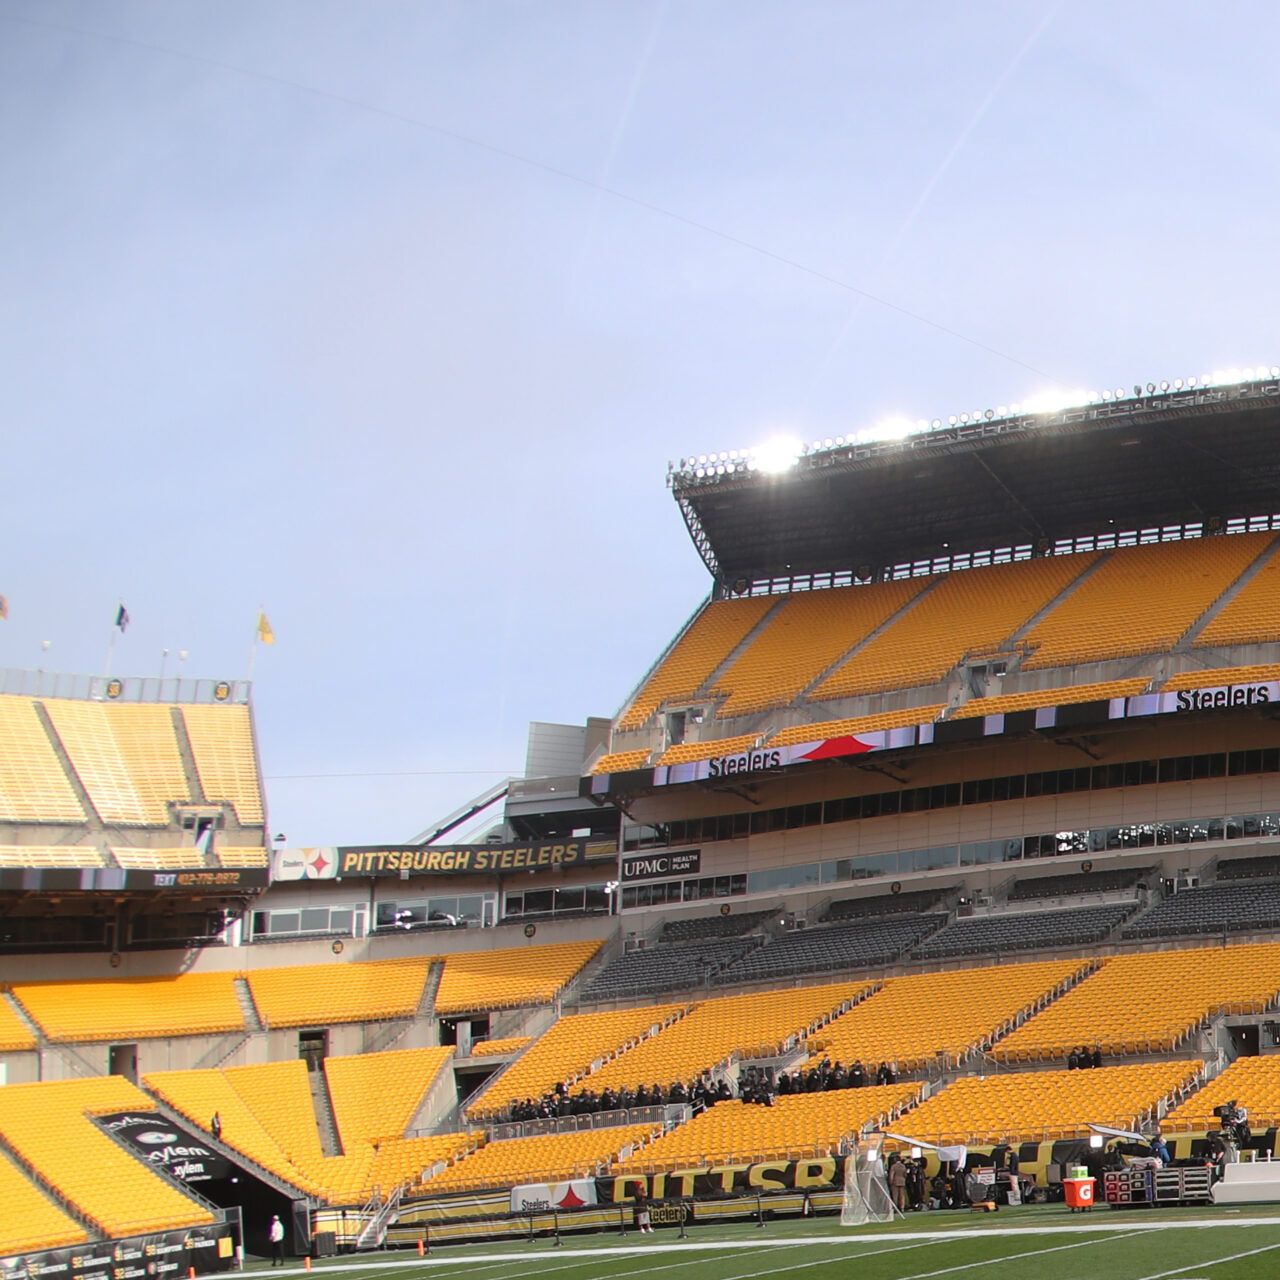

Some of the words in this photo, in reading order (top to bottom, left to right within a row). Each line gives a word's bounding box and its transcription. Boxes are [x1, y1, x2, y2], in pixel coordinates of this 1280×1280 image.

[1177, 685, 1270, 712] Steelers
[708, 751, 780, 778] Steelers
[343, 851, 470, 872] PITTSBURGH
[473, 843, 579, 871] STEELERS
[672, 855, 698, 863] HEALTH
[624, 858, 668, 877] UPMC
[145, 1146, 210, 1165] xylem
[174, 1161, 204, 1178] xylem
[1079, 1185, 1091, 1199] G
[521, 1198, 550, 1211] Steelers
[650, 1202, 687, 1223] teelers
